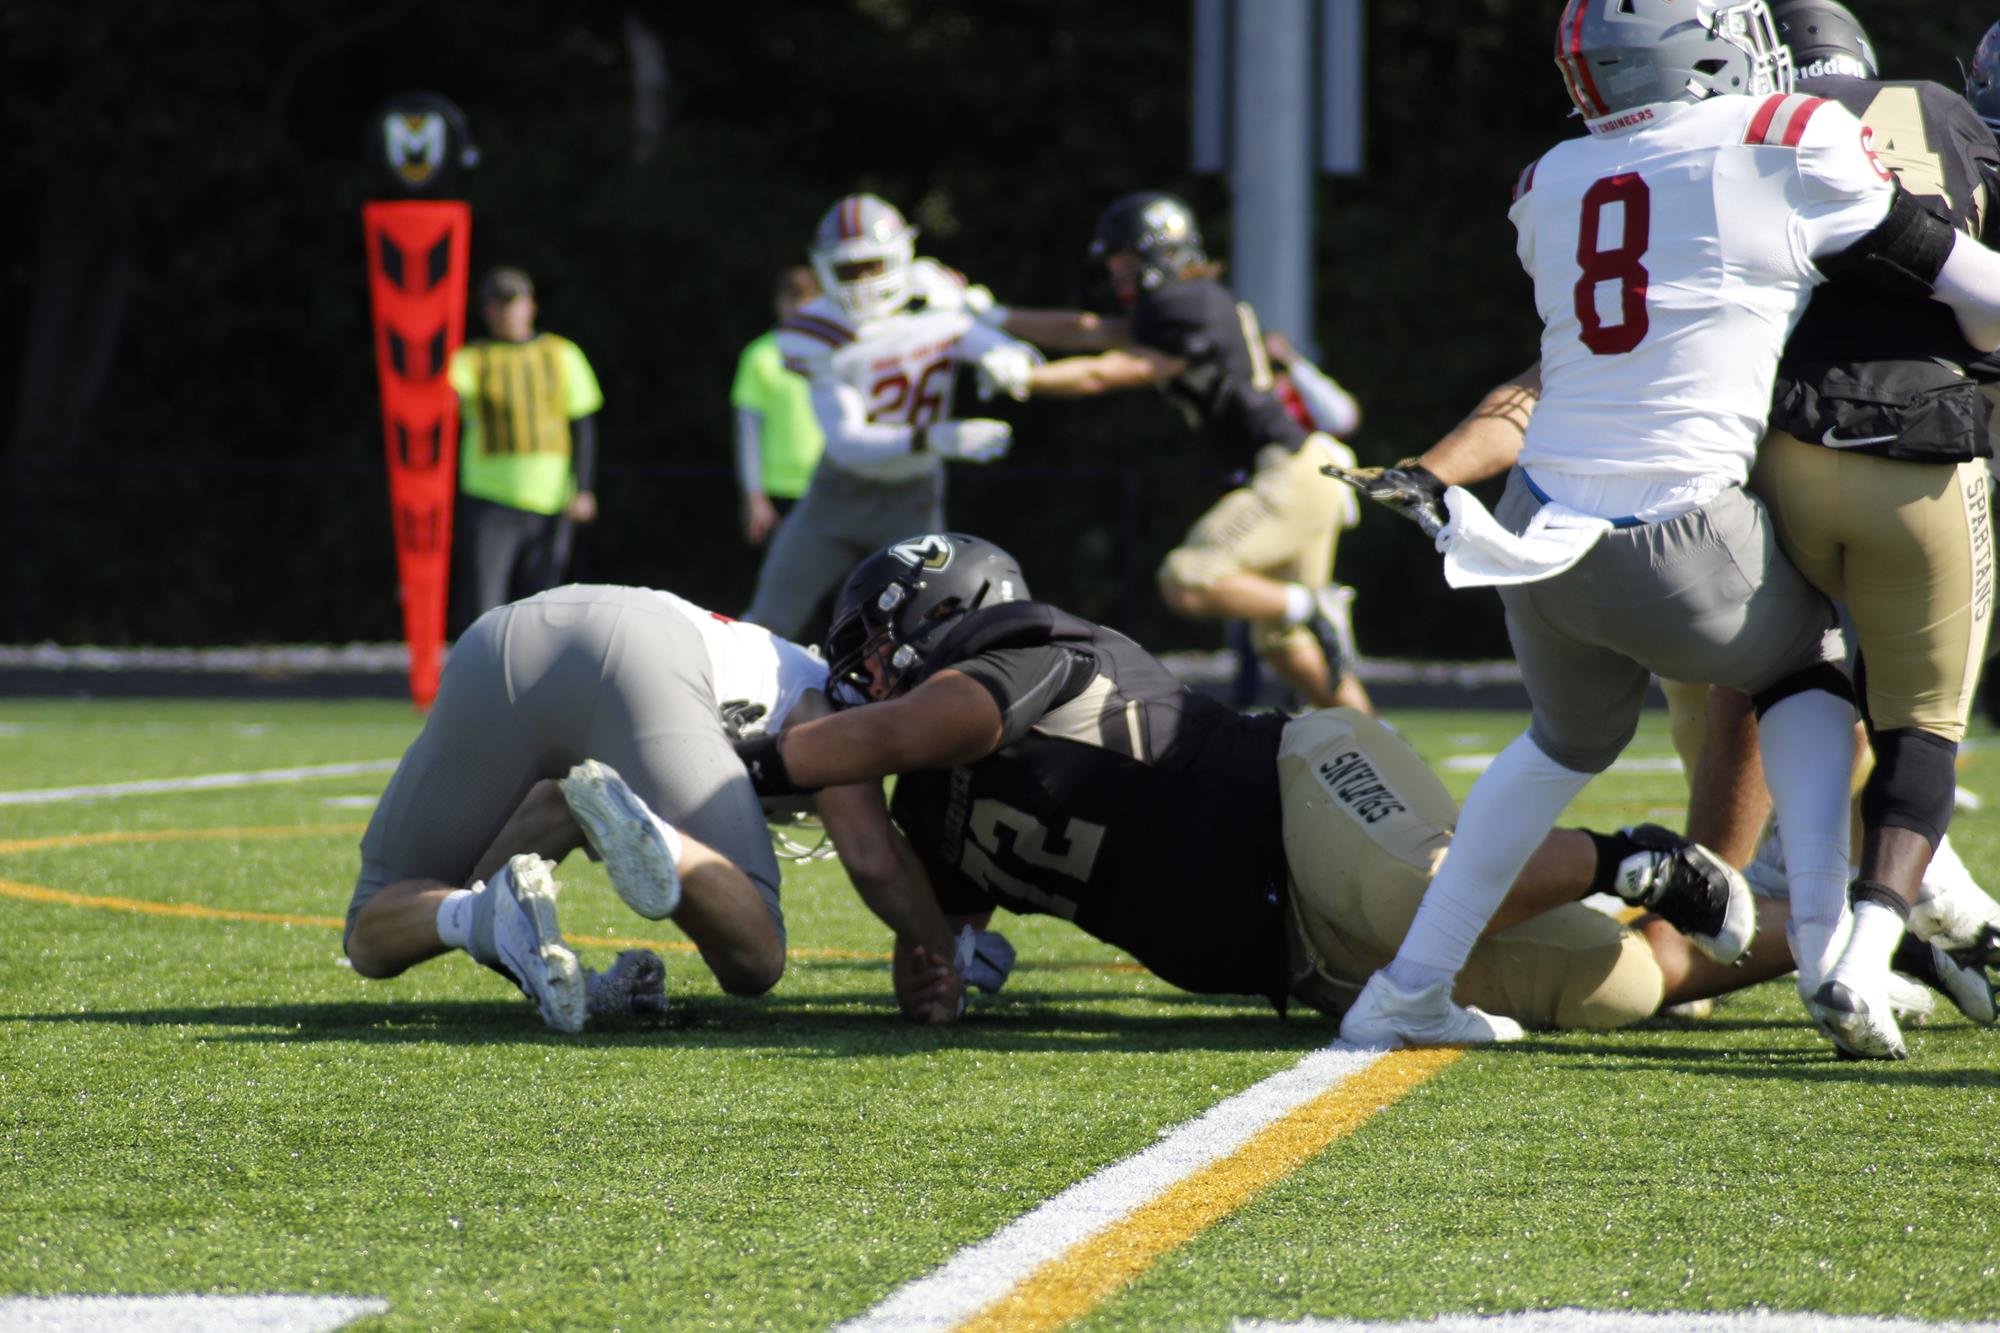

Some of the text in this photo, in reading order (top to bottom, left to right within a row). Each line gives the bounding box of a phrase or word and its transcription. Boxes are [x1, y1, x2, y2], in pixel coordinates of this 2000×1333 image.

[1599, 108, 1655, 134] ENGINEERS
[1574, 171, 1651, 356] 8
[865, 358, 951, 426] 26
[1966, 477, 1993, 622] SPARTANS
[1320, 752, 1406, 823] SPARTANS
